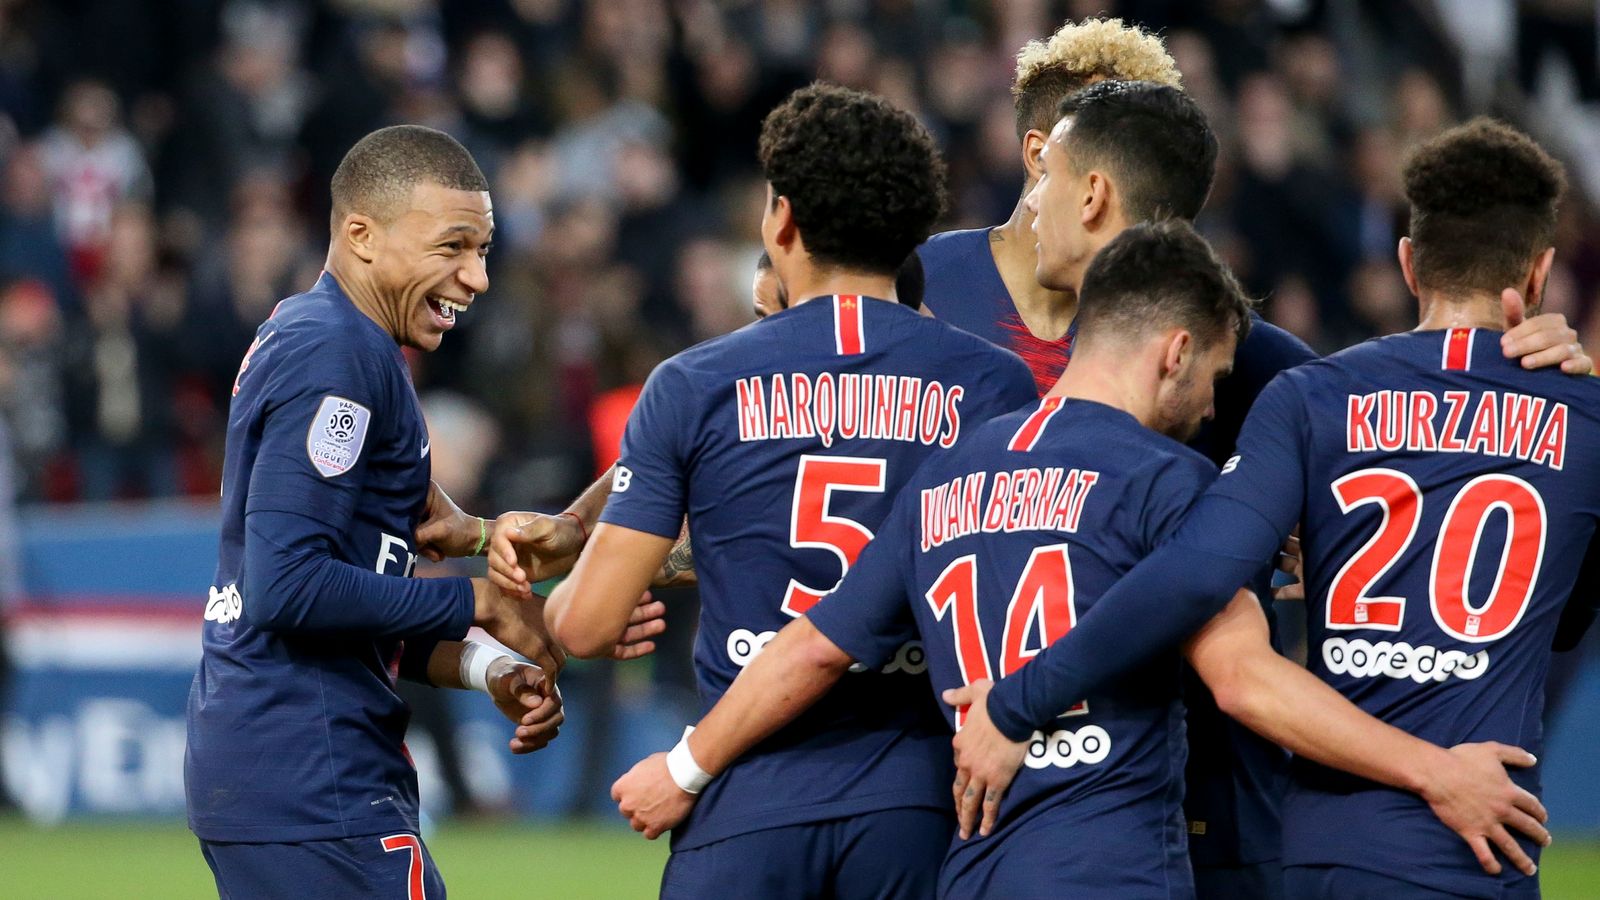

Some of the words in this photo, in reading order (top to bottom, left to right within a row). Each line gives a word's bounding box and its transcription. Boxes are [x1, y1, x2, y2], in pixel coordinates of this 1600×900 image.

[339, 402, 359, 414] PARIS
[735, 372, 964, 448] MARQUINHOS
[1346, 390, 1569, 470] KURZAWA
[781, 454, 887, 618] 5
[920, 471, 986, 552] JUAN
[983, 468, 1099, 533] BERNAT
[1325, 468, 1547, 643] 20
[926, 543, 1089, 733] 14
[1322, 637, 1489, 684] ooredoo
[380, 834, 426, 900] 7
